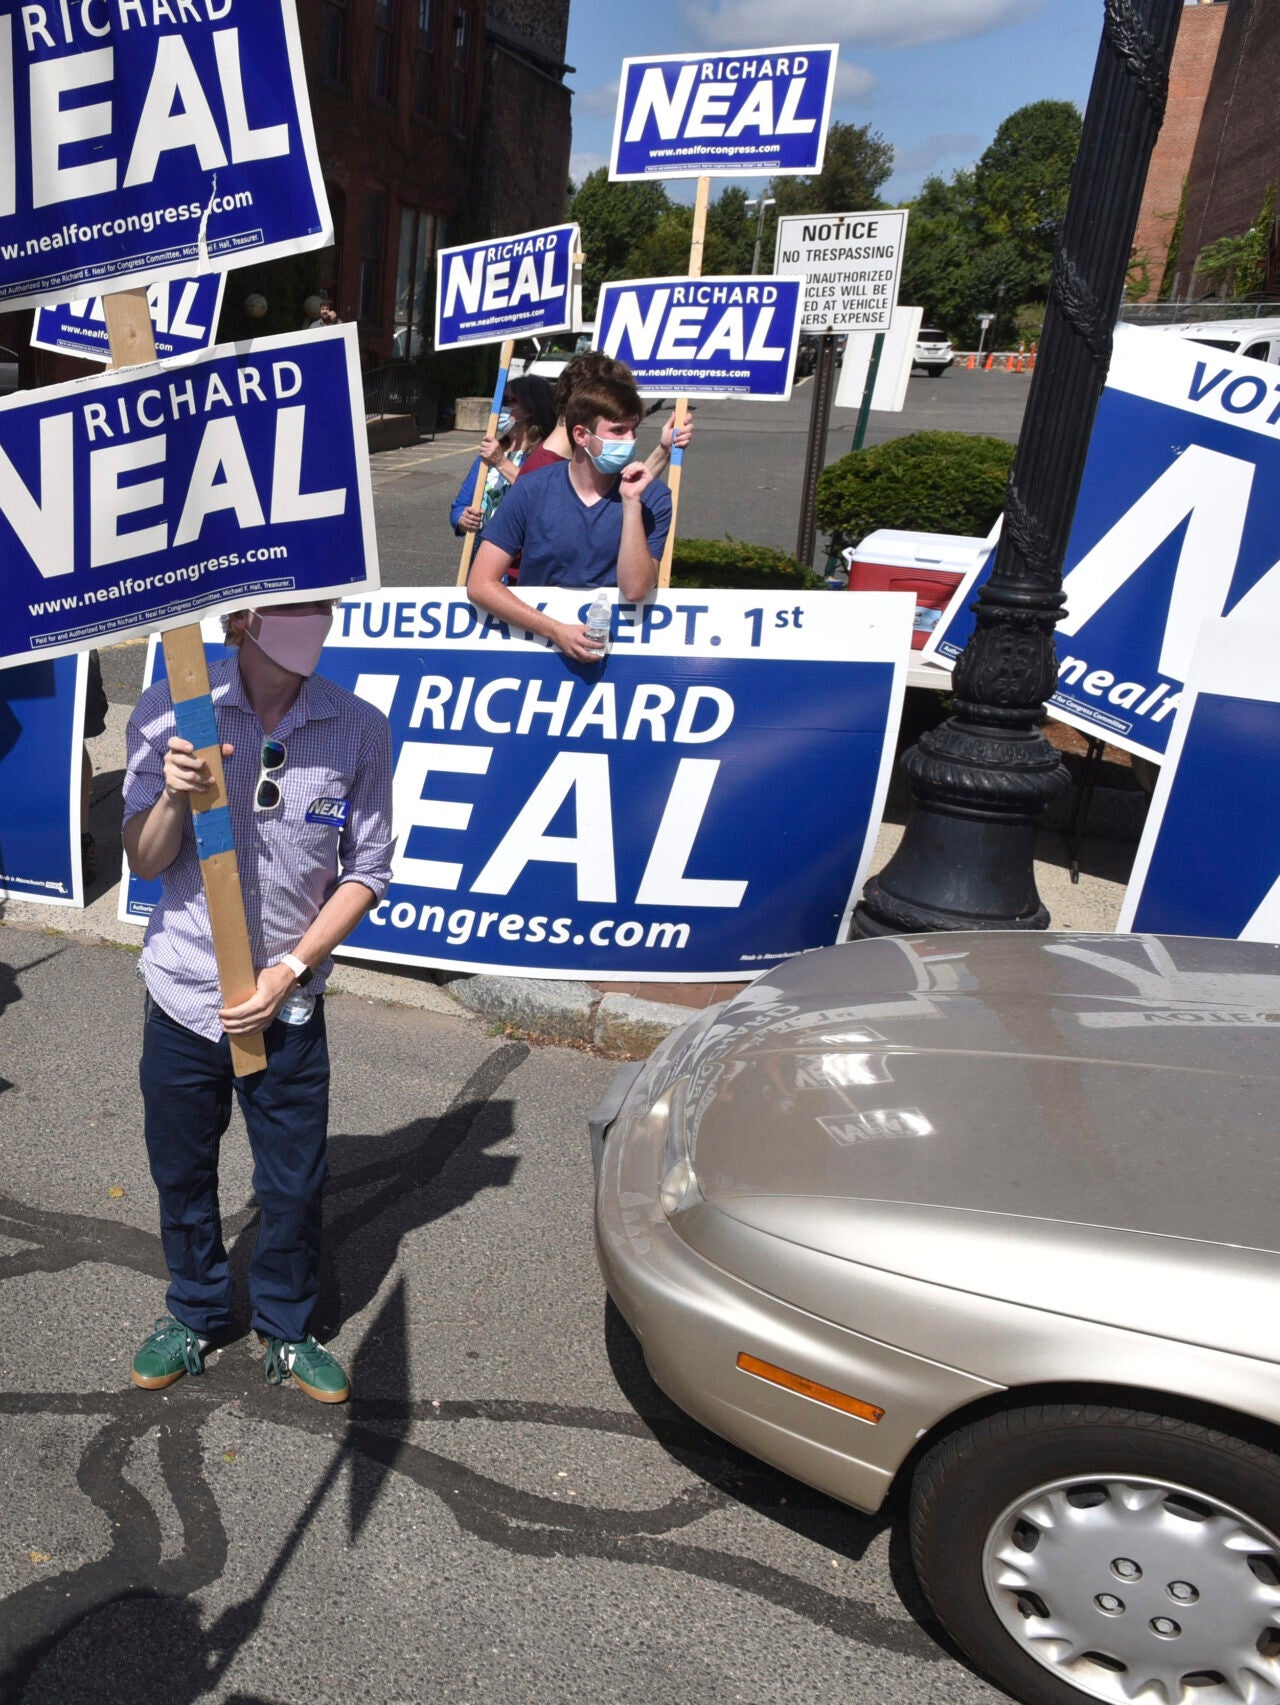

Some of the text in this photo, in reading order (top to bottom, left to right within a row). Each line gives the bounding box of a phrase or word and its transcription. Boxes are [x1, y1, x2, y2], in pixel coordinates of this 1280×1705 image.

[701, 57, 808, 80] RICHARD
[624, 65, 817, 142] NEAL
[649, 144, 780, 158] www.nealforcongress.com
[802, 221, 878, 242] NOTICE
[487, 235, 558, 263] RICHARD
[782, 245, 894, 263] NO TRESPASSING
[62, 271, 84, 282] Richard
[92, 267, 106, 276] Neal
[117, 256, 145, 270] Congress
[806, 270, 893, 284] UNAUTHORIZED
[443, 250, 565, 318] NEAL
[673, 286, 778, 304] RICHARD
[805, 284, 887, 298] ICLES WILL BE
[823, 300, 837, 311] AT
[842, 298, 888, 310] VEHICLE
[603, 288, 786, 361] NEAL
[801, 312, 885, 325] NERS EXPENSE
[630, 367, 751, 378] ww.nealforcongress.com
[83, 361, 302, 441] RICHARD
[1188, 360, 1280, 425] VOT
[28, 545, 288, 617] www.nealforcongress.com
[167, 603, 191, 614] Congress
[222, 587, 243, 598] Michael
[744, 605, 805, 648] 1st
[409, 674, 734, 744] RICHARD
[353, 674, 748, 908] EAL
[309, 800, 345, 819] NEAL
[368, 899, 691, 949] congress.com
